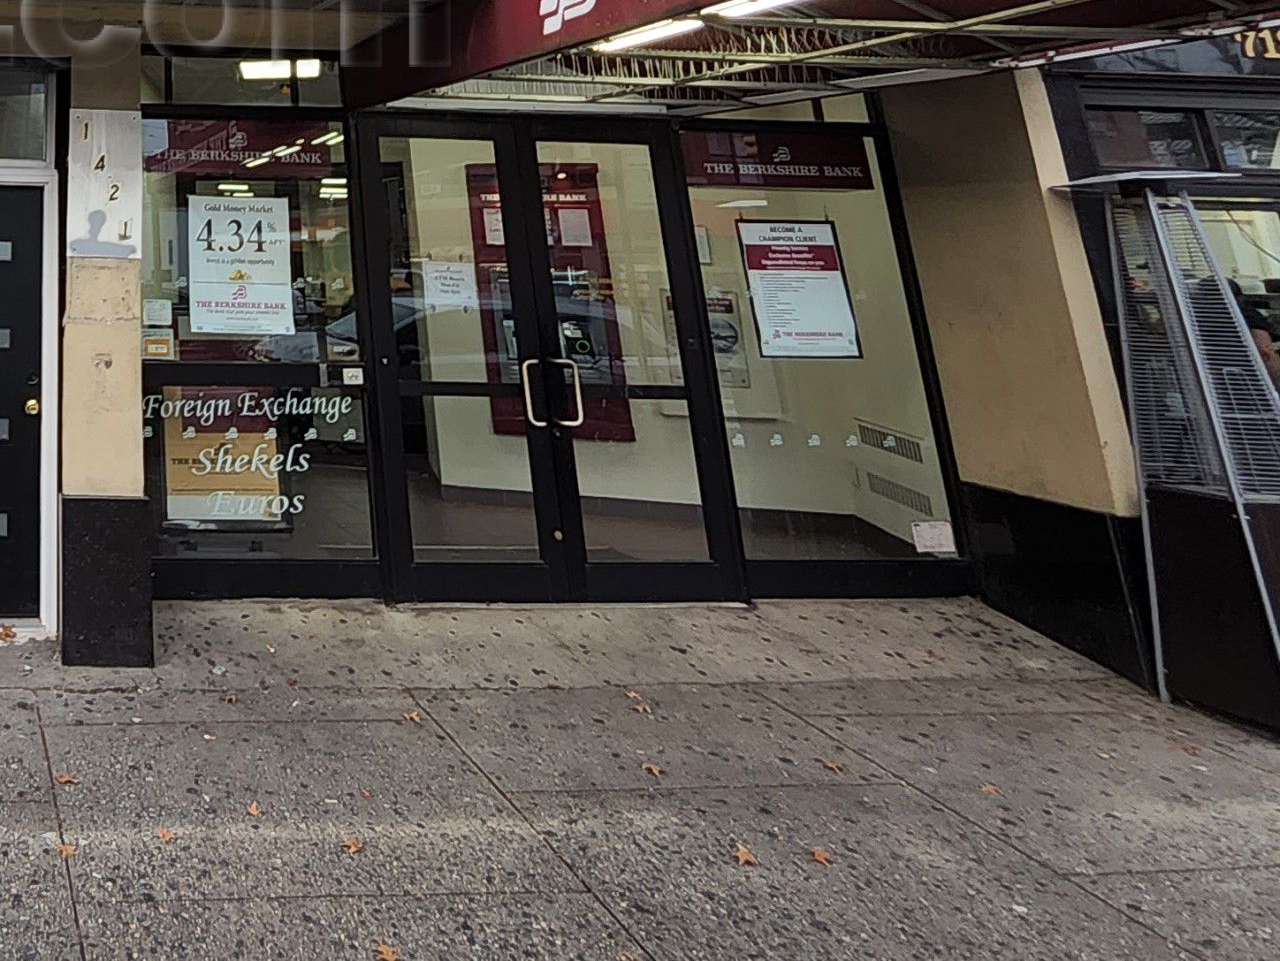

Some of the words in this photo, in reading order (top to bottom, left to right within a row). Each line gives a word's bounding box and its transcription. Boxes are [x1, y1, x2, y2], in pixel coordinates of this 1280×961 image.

[1233, 29, 1280, 59] 71
[156, 150, 186, 160] THE
[189, 150, 275, 163] BERKSHI
[281, 153, 323, 164] BANK
[703, 162, 735, 174] THE
[737, 163, 820, 176] BERKSHIRE
[823, 165, 863, 177] BANK
[204, 204, 221, 212] Gold
[248, 204, 273, 213] Market
[195, 218, 267, 253] 4.34
[196, 300, 212, 308] THE
[214, 301, 262, 309] BERKSHIRE
[264, 302, 286, 310] BANK
[143, 392, 232, 427] Foreign
[238, 388, 353, 424] Exchange
[191, 443, 311, 479] Shekels
[206, 490, 305, 517] Euros
